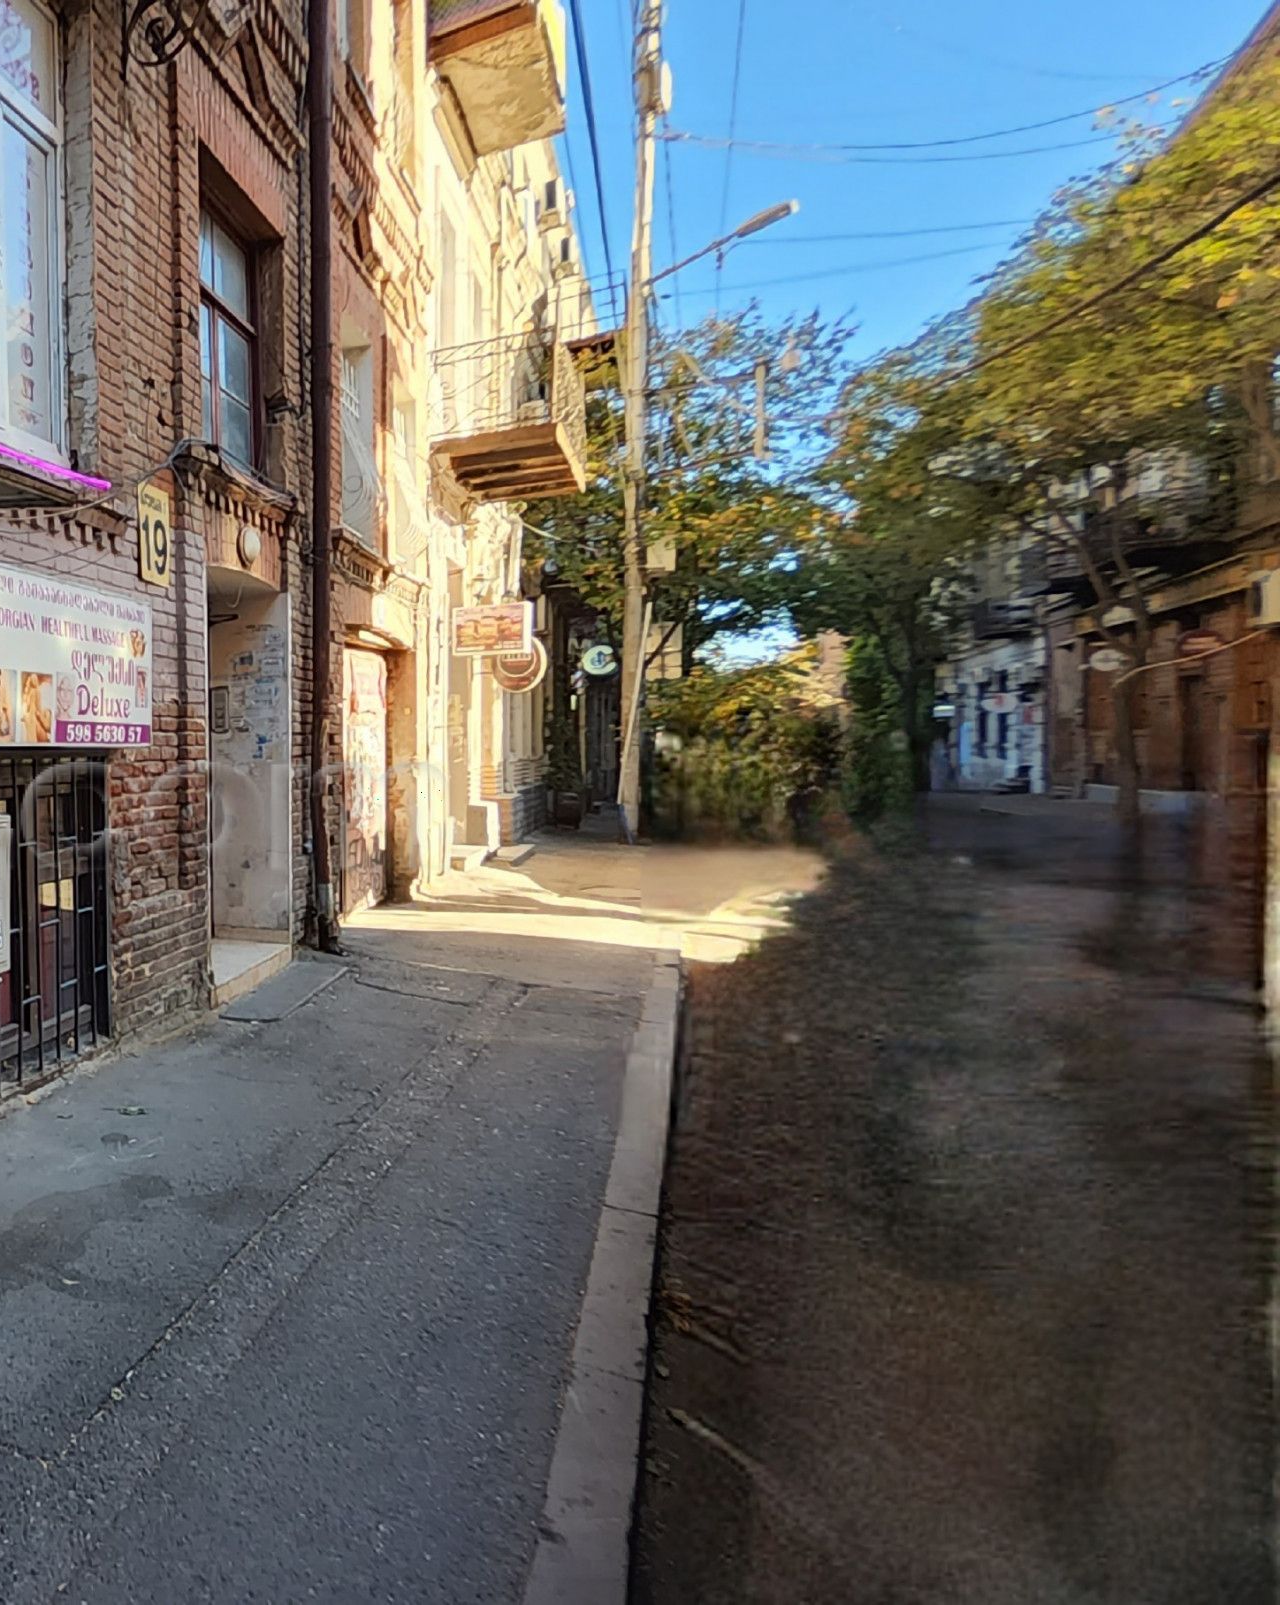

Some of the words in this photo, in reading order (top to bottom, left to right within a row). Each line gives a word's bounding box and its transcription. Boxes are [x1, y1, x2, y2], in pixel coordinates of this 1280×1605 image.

[142, 514, 168, 575] 19
[41, 615, 89, 642] HEALTHFUL
[76, 684, 131, 718] Deluxe
[66, 724, 91, 742] 598
[127, 726, 142, 743] 57
